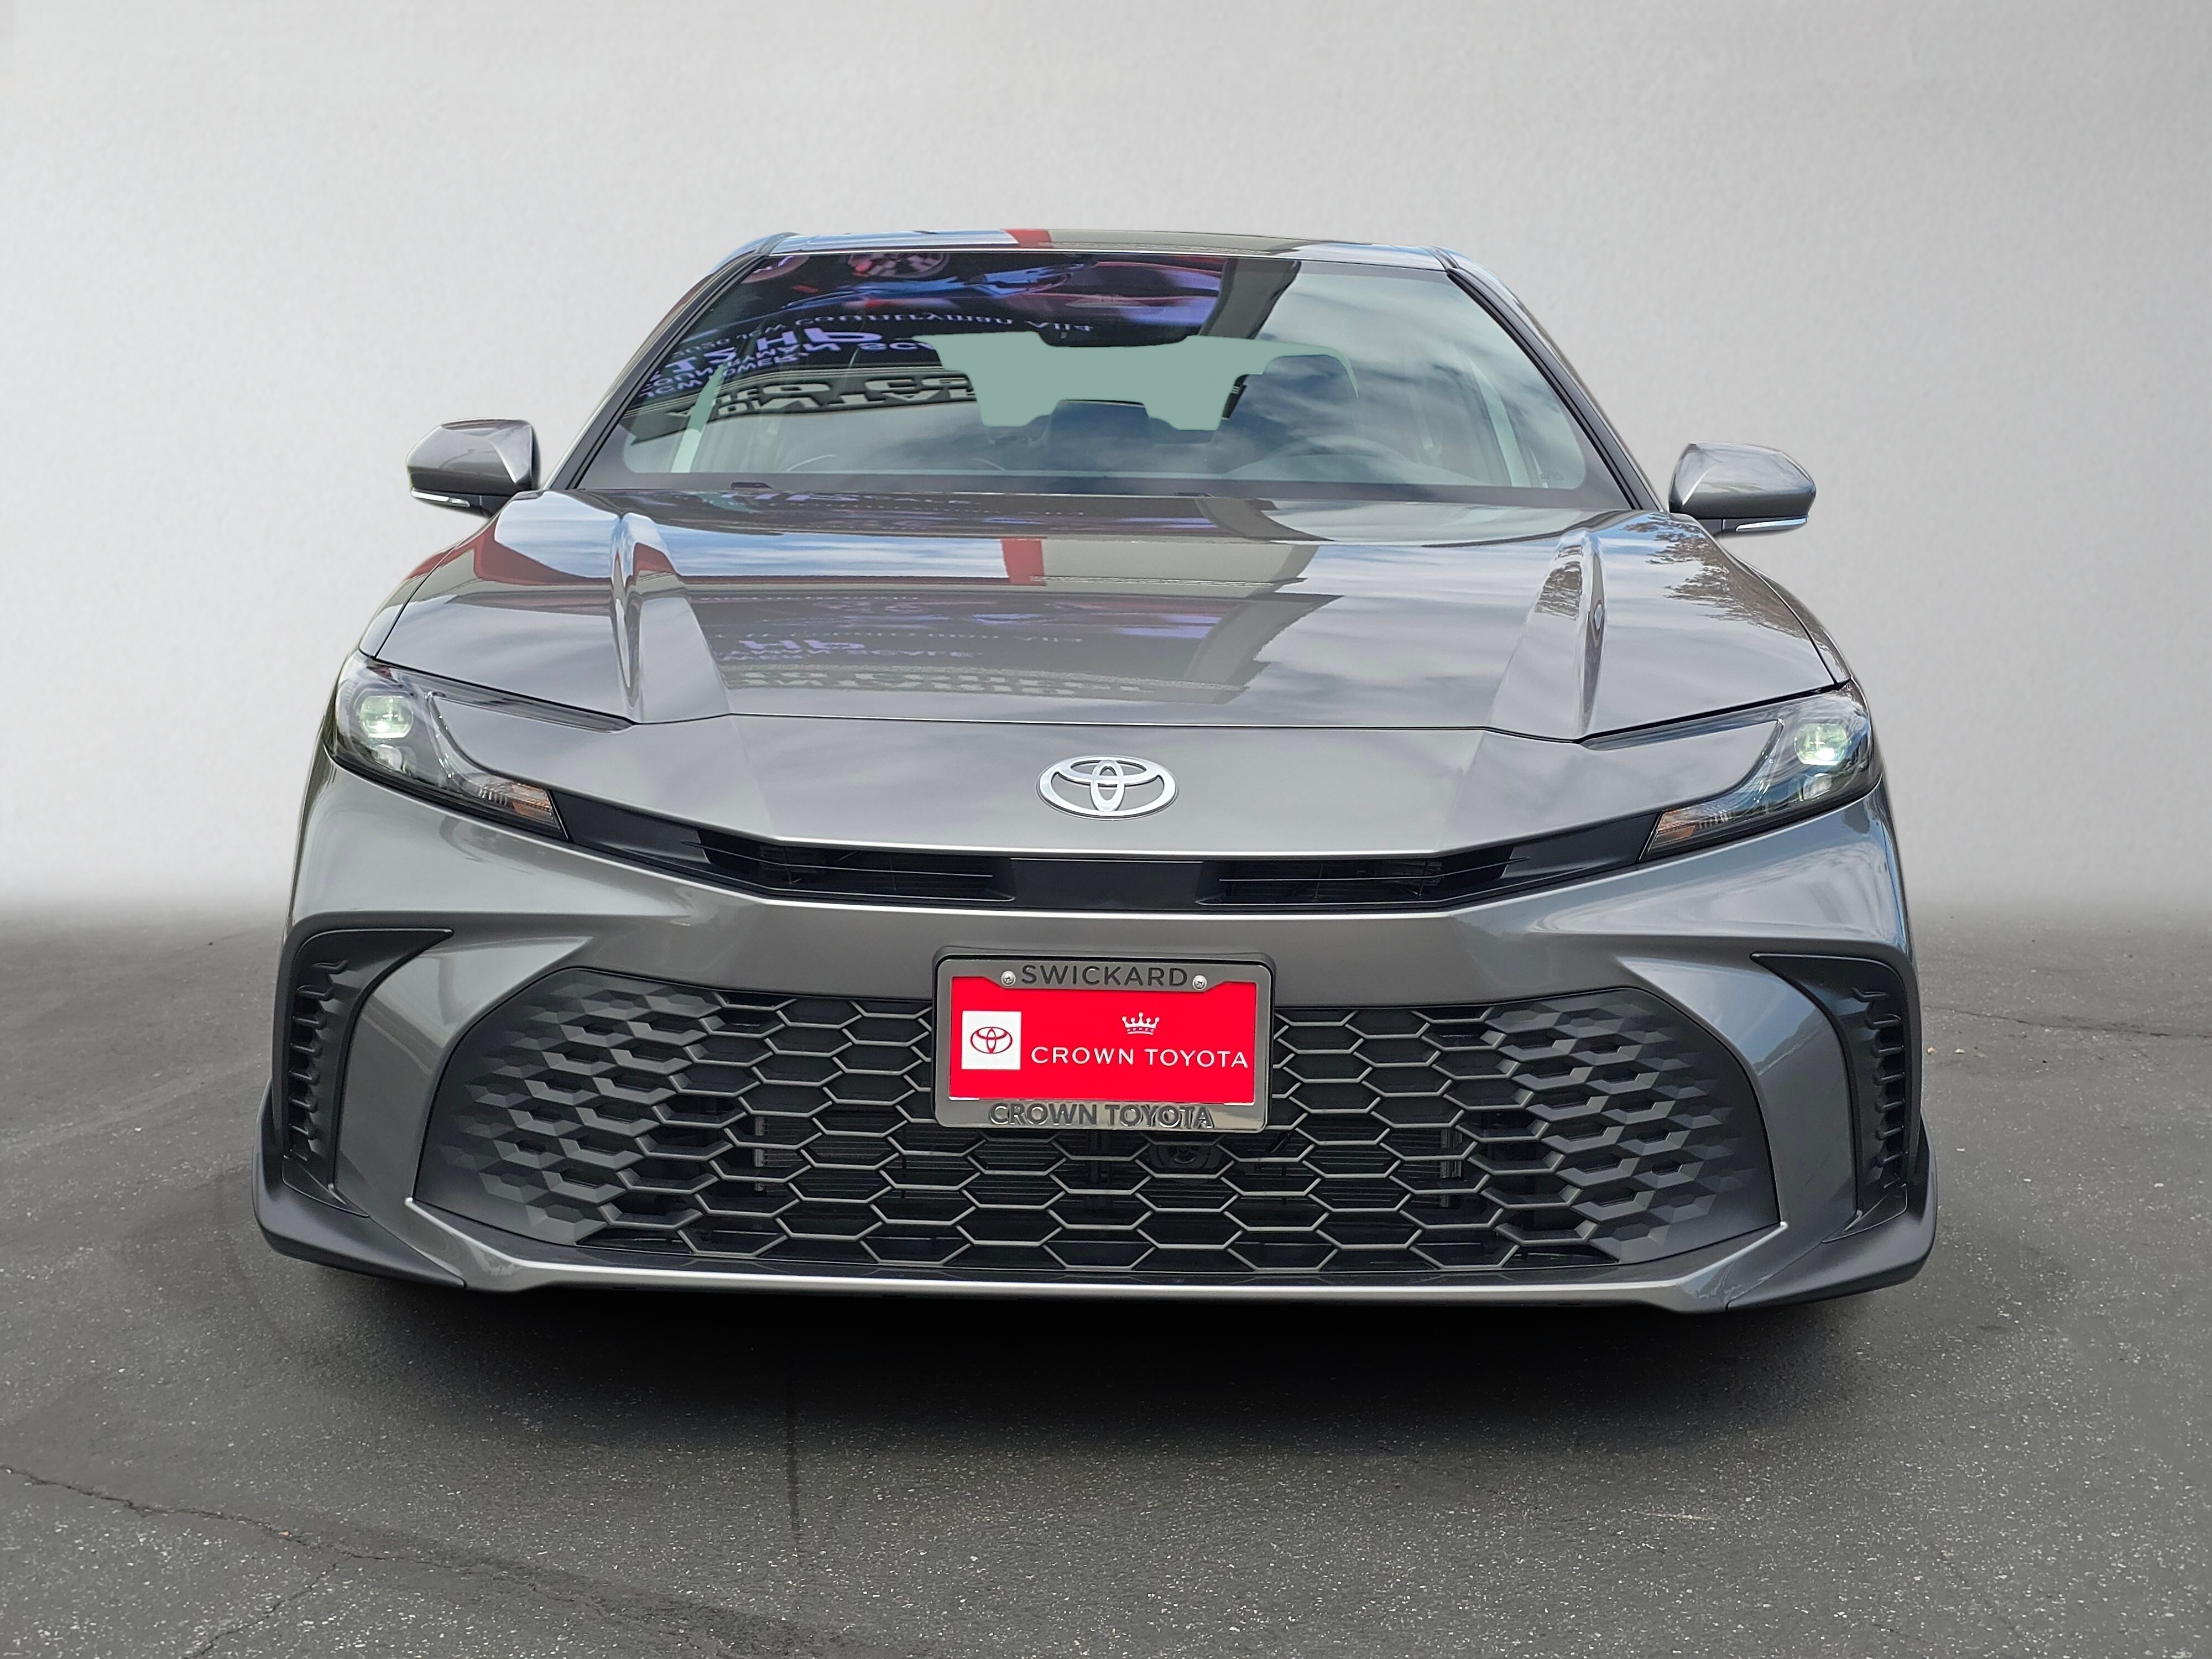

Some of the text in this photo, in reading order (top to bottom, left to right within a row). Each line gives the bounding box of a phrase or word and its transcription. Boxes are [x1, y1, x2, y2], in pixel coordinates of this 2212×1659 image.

[1021, 964, 1188, 987] SWICKARD
[1031, 1046, 1249, 1068] CROWN TOYOTA
[989, 1104, 1214, 1129] CROWN TOYOTA
